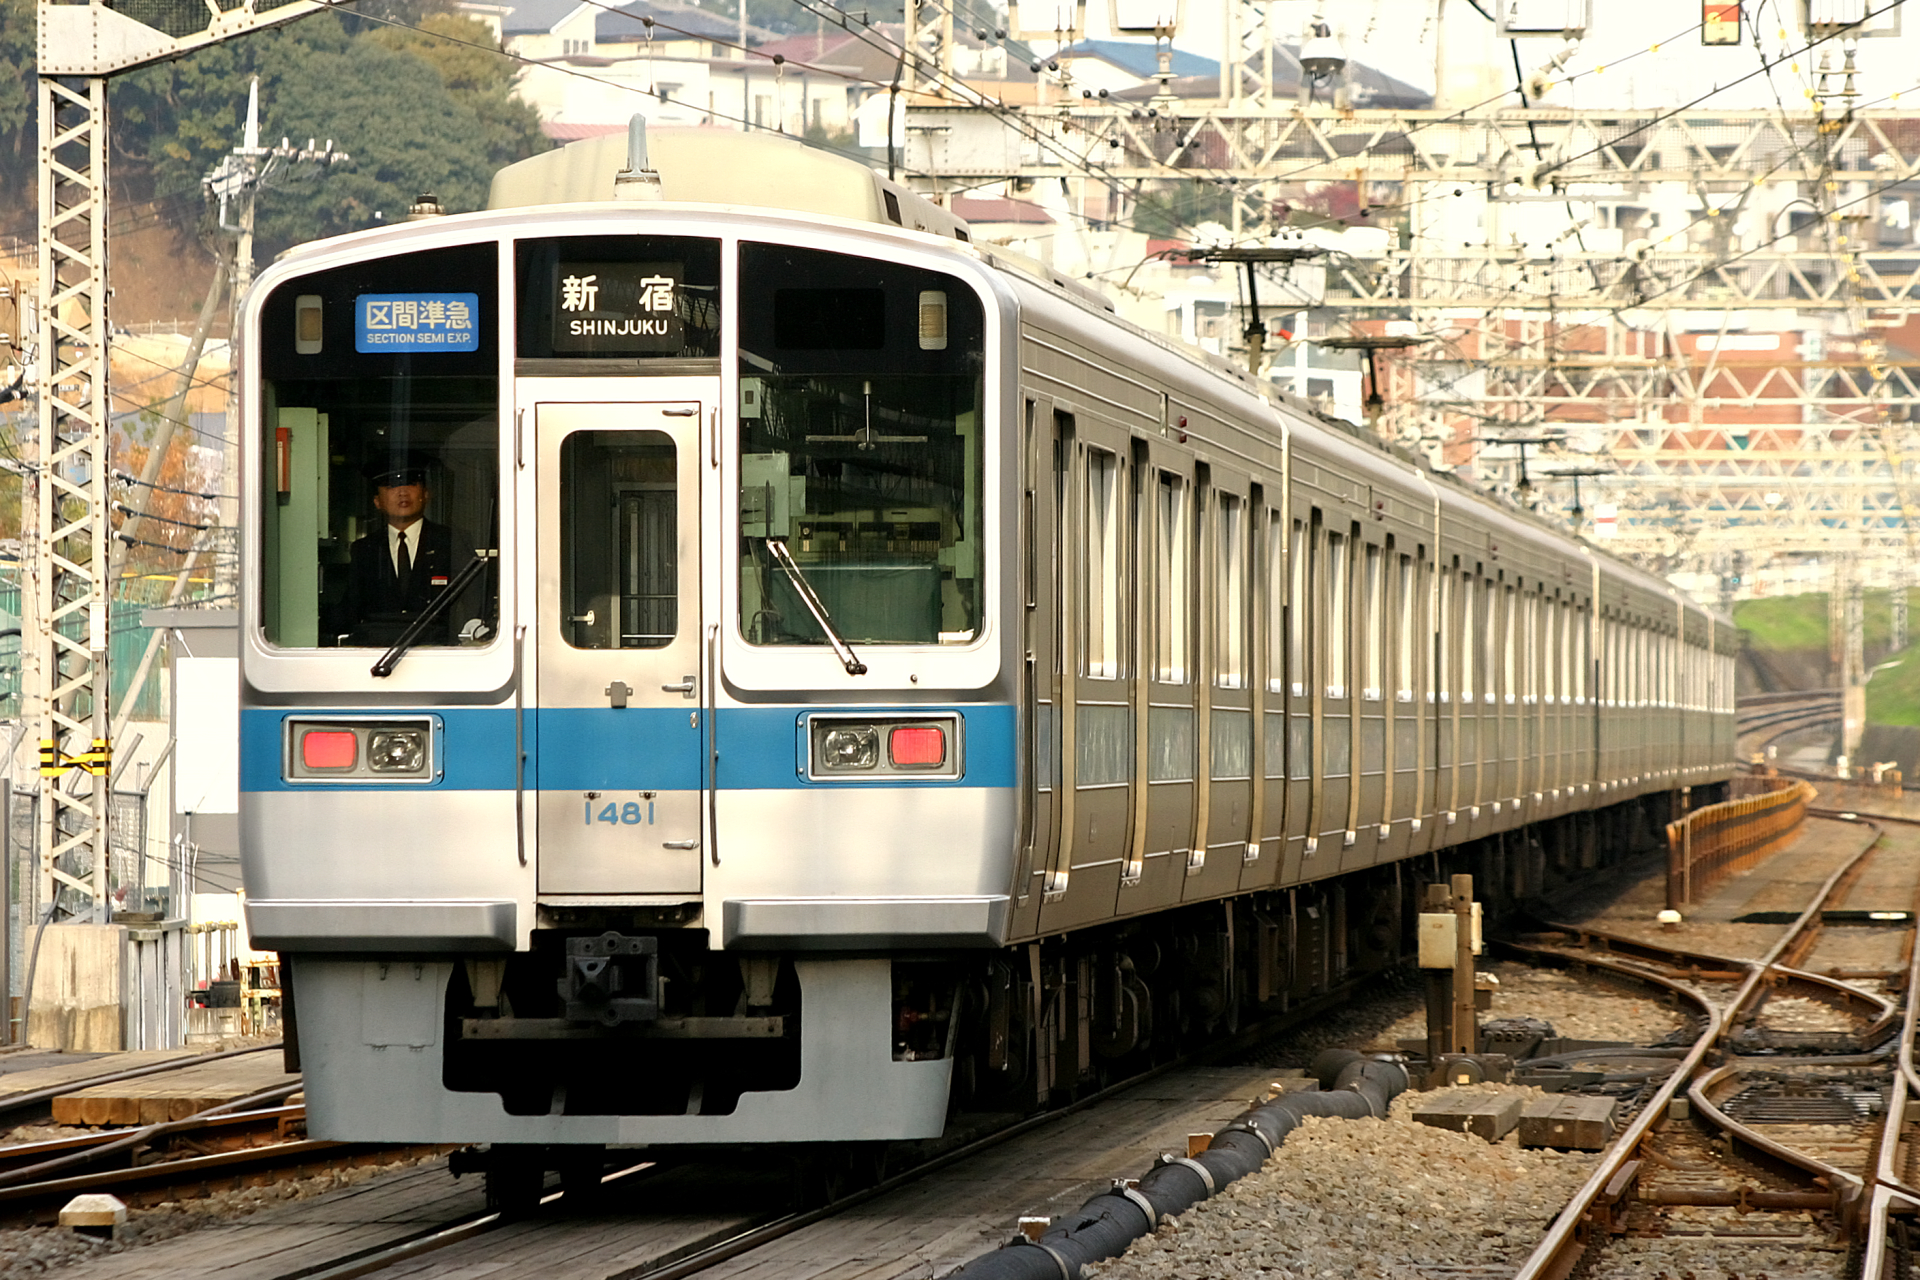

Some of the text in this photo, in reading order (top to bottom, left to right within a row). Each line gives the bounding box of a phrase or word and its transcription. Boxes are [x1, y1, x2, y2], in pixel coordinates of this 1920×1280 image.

[561, 274, 674, 312] 新宿
[366, 300, 472, 330] 区間準急
[570, 319, 668, 335] SHINJUKU
[366, 332, 472, 344] SECTION SEMI EXP.
[585, 801, 654, 825] 1481
